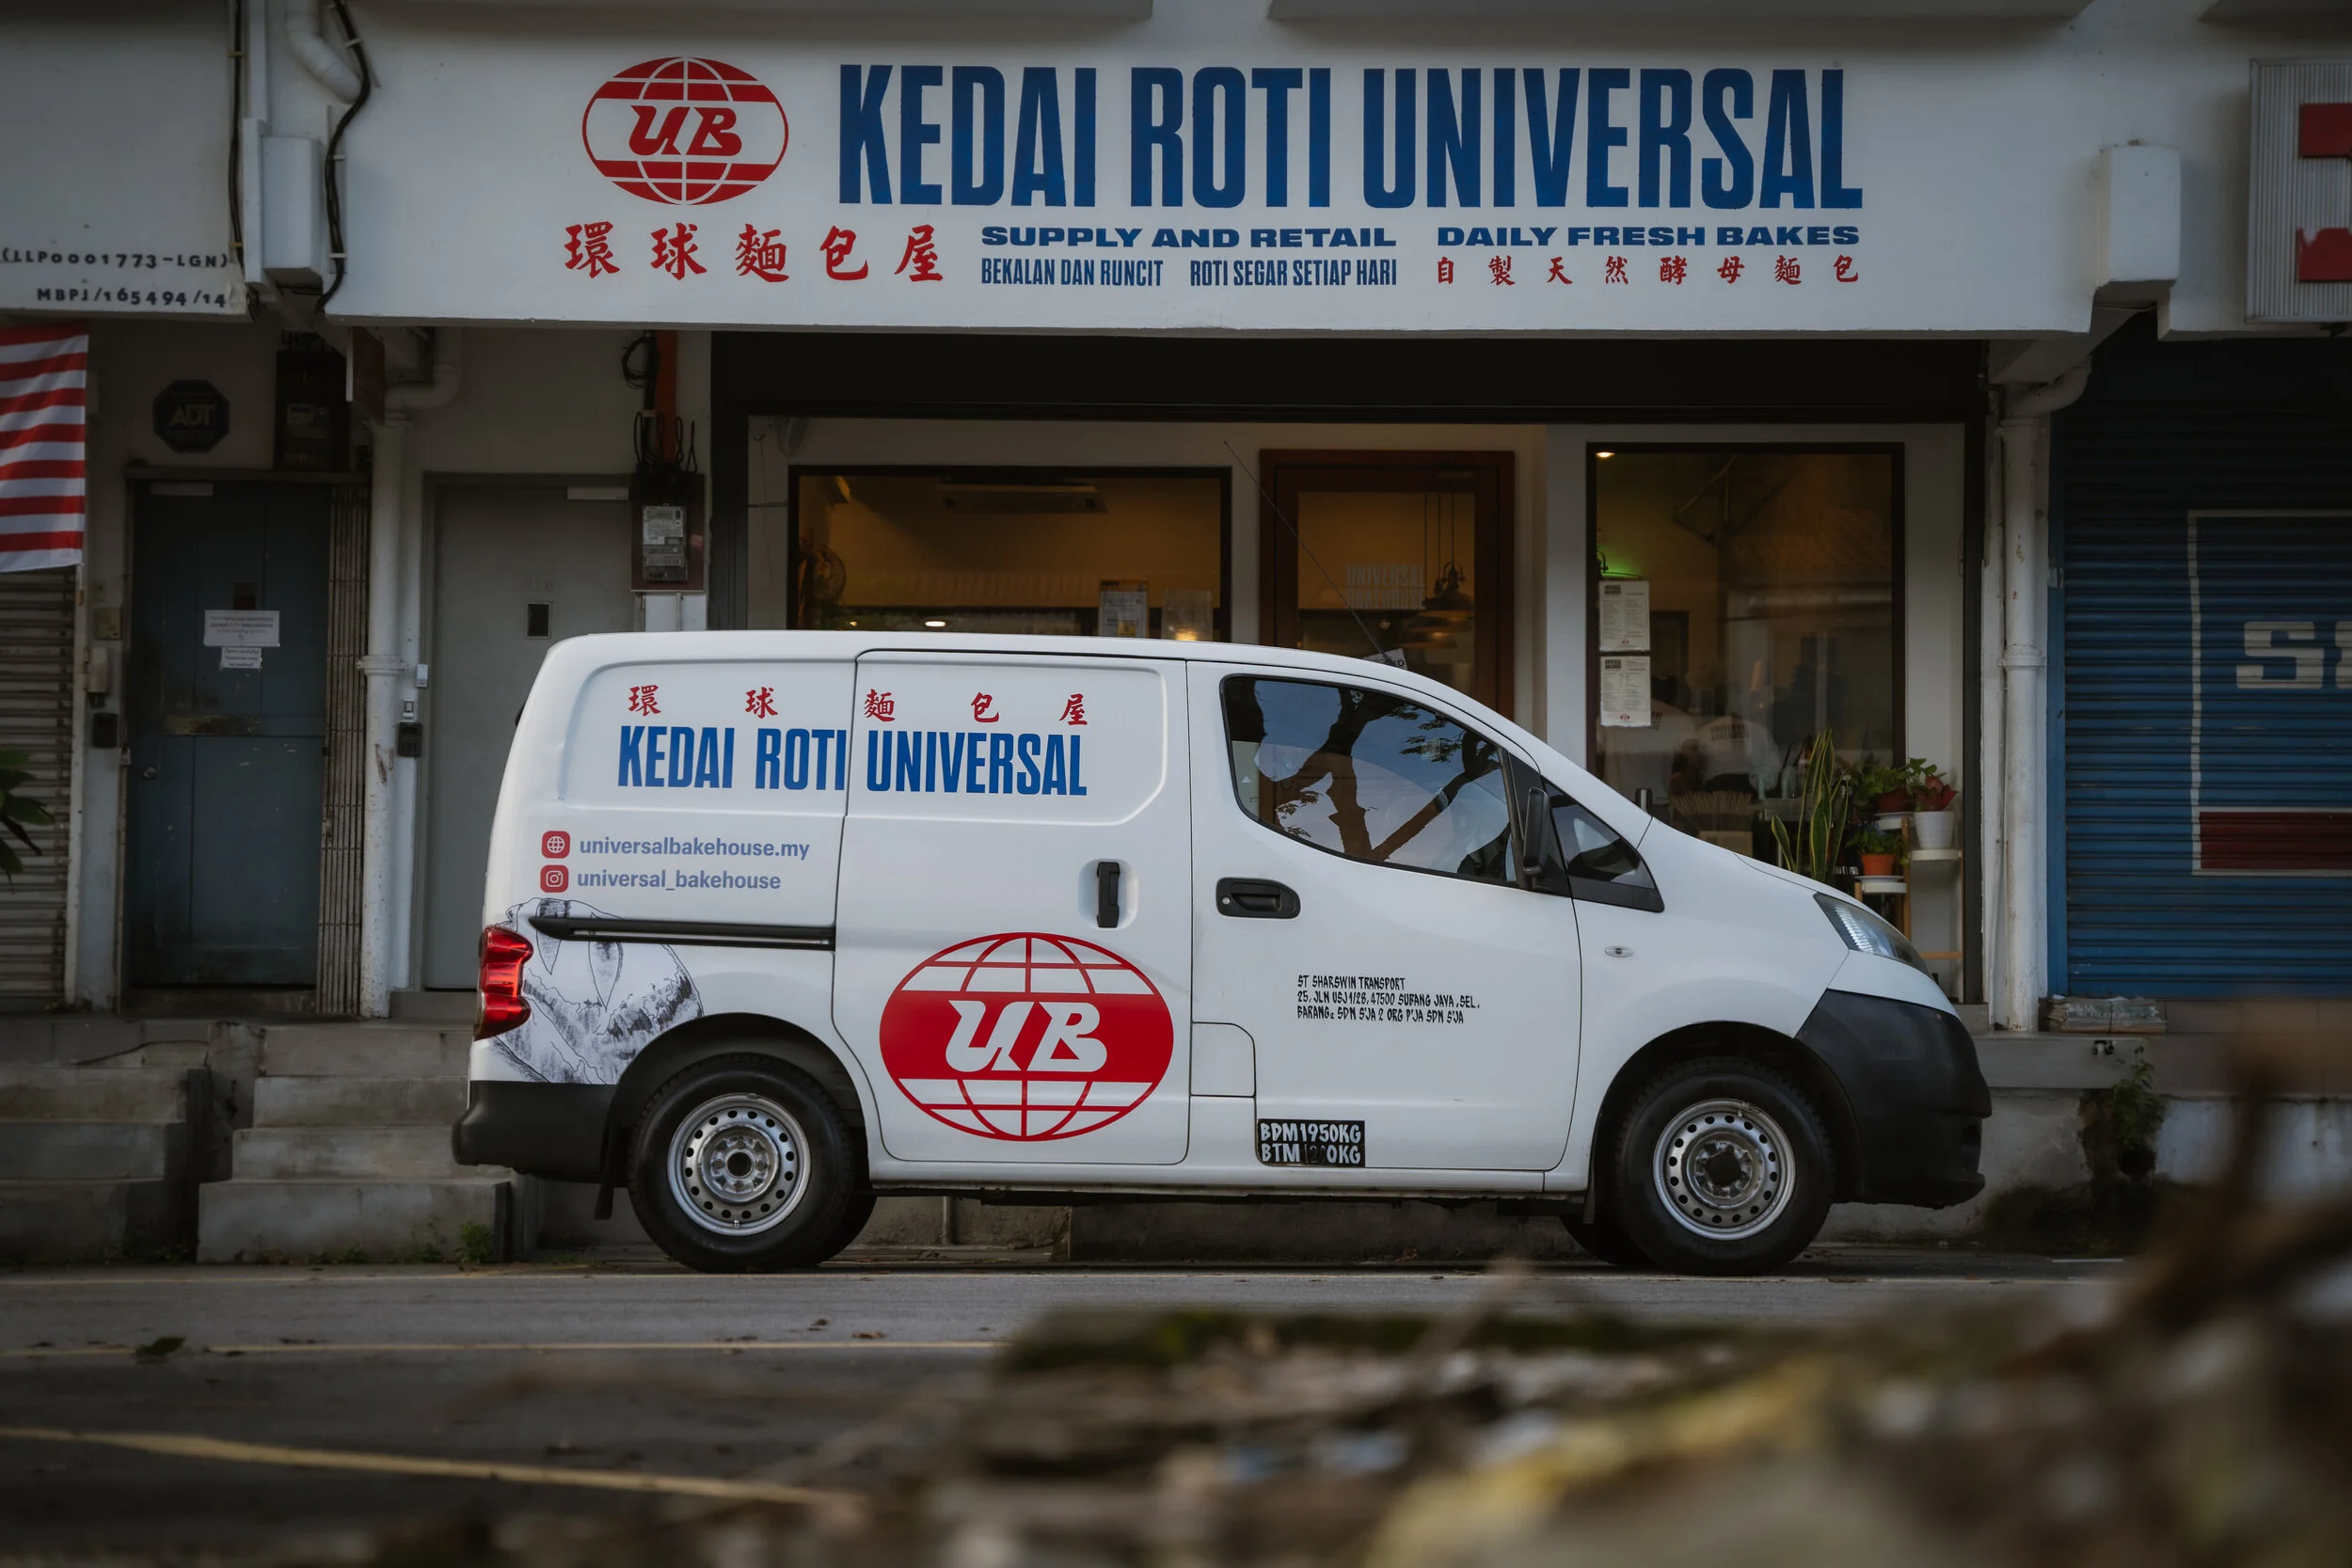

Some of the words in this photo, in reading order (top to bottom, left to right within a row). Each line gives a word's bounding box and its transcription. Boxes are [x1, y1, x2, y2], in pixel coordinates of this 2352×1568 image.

[628, 104, 742, 157] UB
[839, 64, 1096, 206] KEDAI
[1131, 66, 1331, 208] ROTI
[1363, 68, 1863, 210] UNIVERSAL
[981, 226, 1143, 248] SUPPLY
[1152, 227, 1240, 248] AND
[1250, 227, 1397, 248] RETAIL
[1438, 226, 1559, 246] DAILY
[1567, 226, 1706, 246] FRESH
[1717, 226, 1860, 246] BAKES
[564, 221, 943, 283] 環球麵包屋
[981, 257, 1056, 285] BEKALAN
[1060, 258, 1096, 285] DAN
[1100, 258, 1164, 286] RUNCIT
[1190, 259, 1229, 287] ROTI
[1233, 259, 1288, 287] SEGAR
[1292, 259, 1352, 287] SETIAP
[1356, 259, 1397, 286] HARI
[1437, 254, 1859, 287] 自製天然酵母麵包
[168, 403, 215, 427] ADT
[1346, 563, 1426, 587] UNIVERSAL
[2236, 621, 2352, 689] S
[628, 684, 1089, 726] 環球麵包屋
[617, 725, 736, 789] KEDAI
[755, 727, 847, 791] ROTI
[866, 730, 1088, 796] UNIVERSAL
[580, 836, 810, 861] universalbakehouse.my
[577, 869, 781, 891] universal_bakehouse
[1297, 974, 1310, 989] ST
[1311, 975, 1357, 990] SHARSWIN
[1359, 976, 1406, 991] TRANSPORT
[1313, 990, 1329, 1004] JLN
[1397, 993, 1431, 1007] SUBANG
[1337, 1006, 1357, 1022] SDN
[1387, 1008, 1403, 1022] ORG
[1426, 1009, 1444, 1024] SDN
[945, 999, 1108, 1073] UB
[1261, 1143, 1301, 1163] BTM
